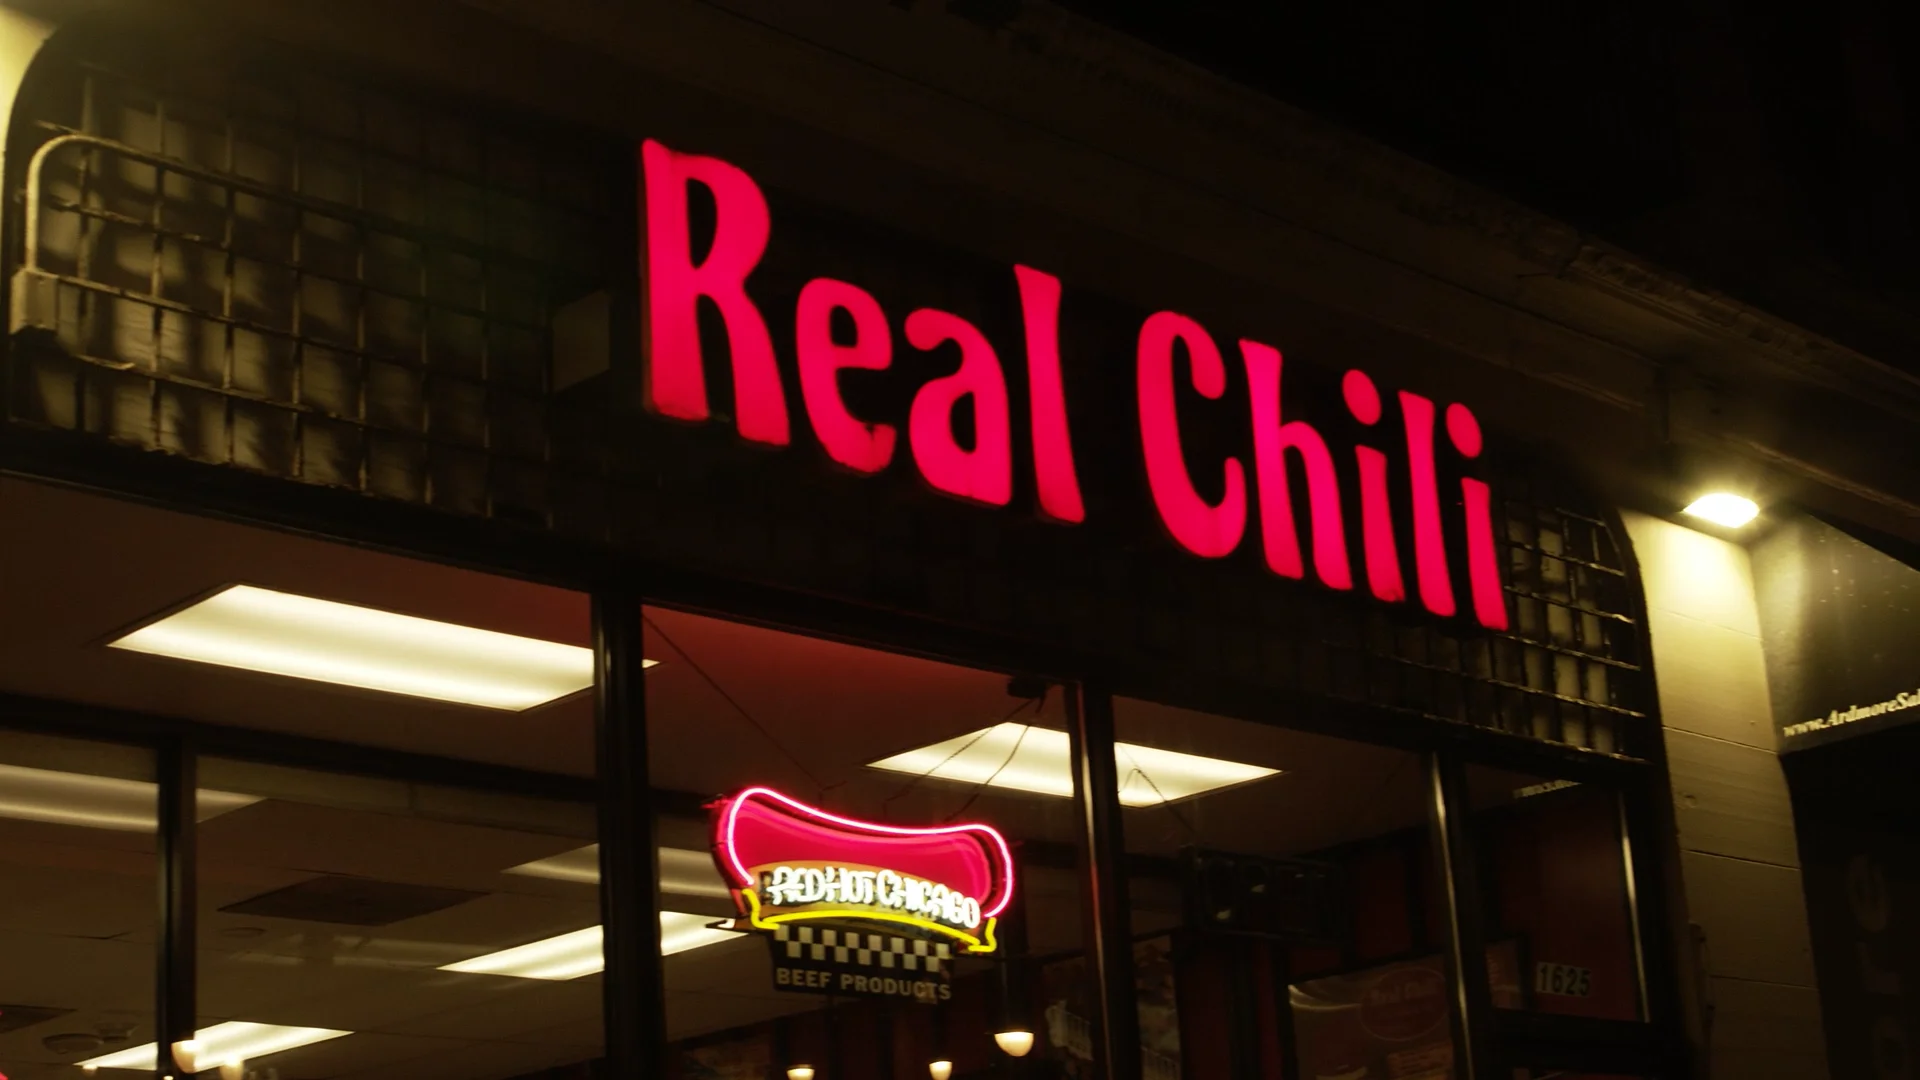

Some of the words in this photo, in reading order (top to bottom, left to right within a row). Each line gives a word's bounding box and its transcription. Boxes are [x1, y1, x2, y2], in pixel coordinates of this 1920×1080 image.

[644, 138, 1085, 524] Real
[1136, 309, 1509, 632] Chili
[767, 866, 825, 905] RED
[824, 867, 876, 902] HOT
[876, 869, 981, 929] CHICAGO
[776, 967, 832, 988] BEEF
[840, 974, 951, 1000] PRODUCTS
[1540, 963, 1591, 996] 1625
